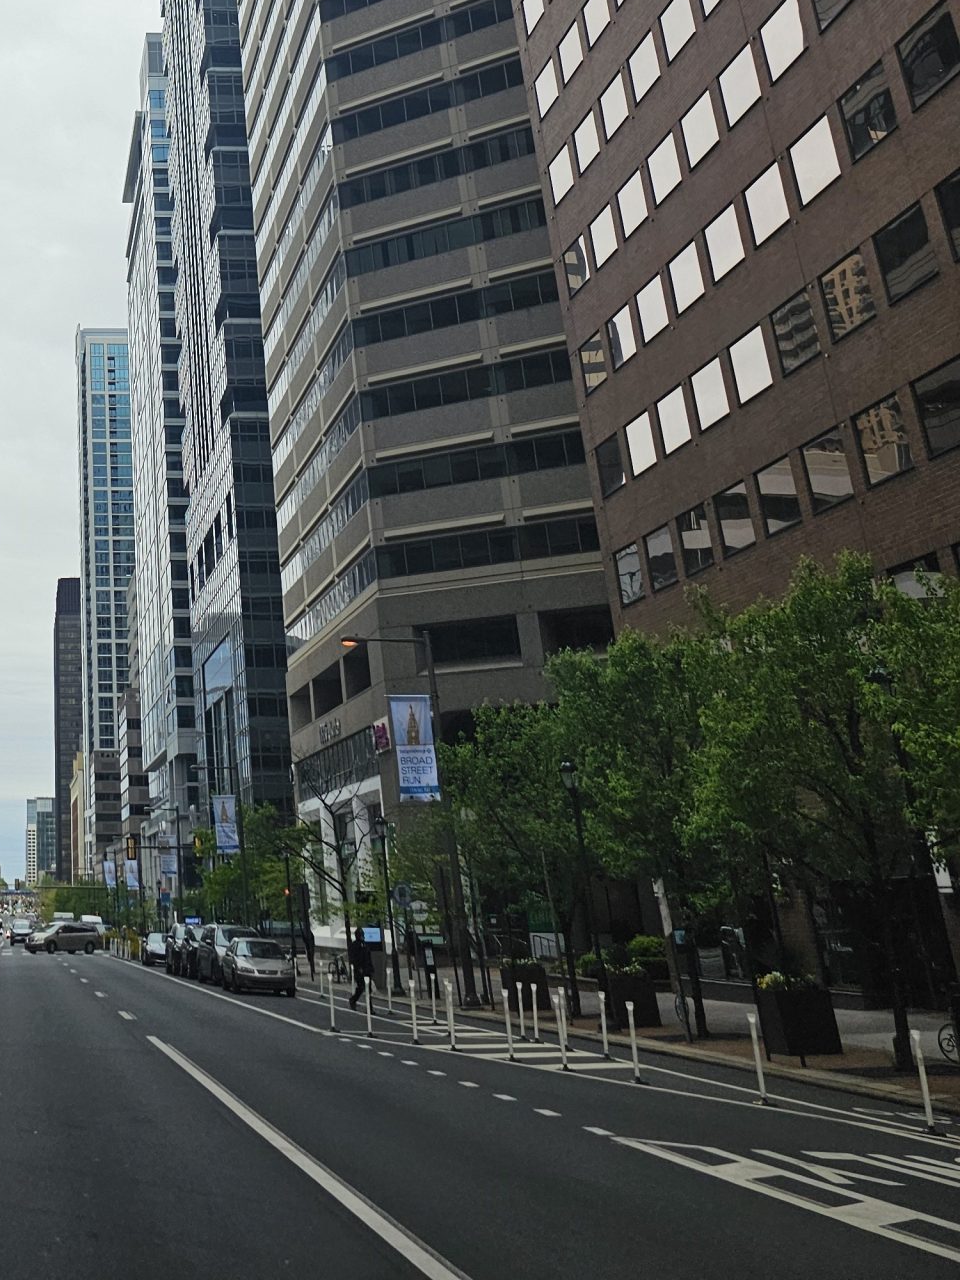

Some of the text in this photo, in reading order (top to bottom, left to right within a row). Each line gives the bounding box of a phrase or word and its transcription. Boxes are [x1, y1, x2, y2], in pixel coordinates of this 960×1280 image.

[400, 756, 433, 765] BROAD
[401, 766, 433, 775] STREET
[402, 776, 421, 784] RUN
